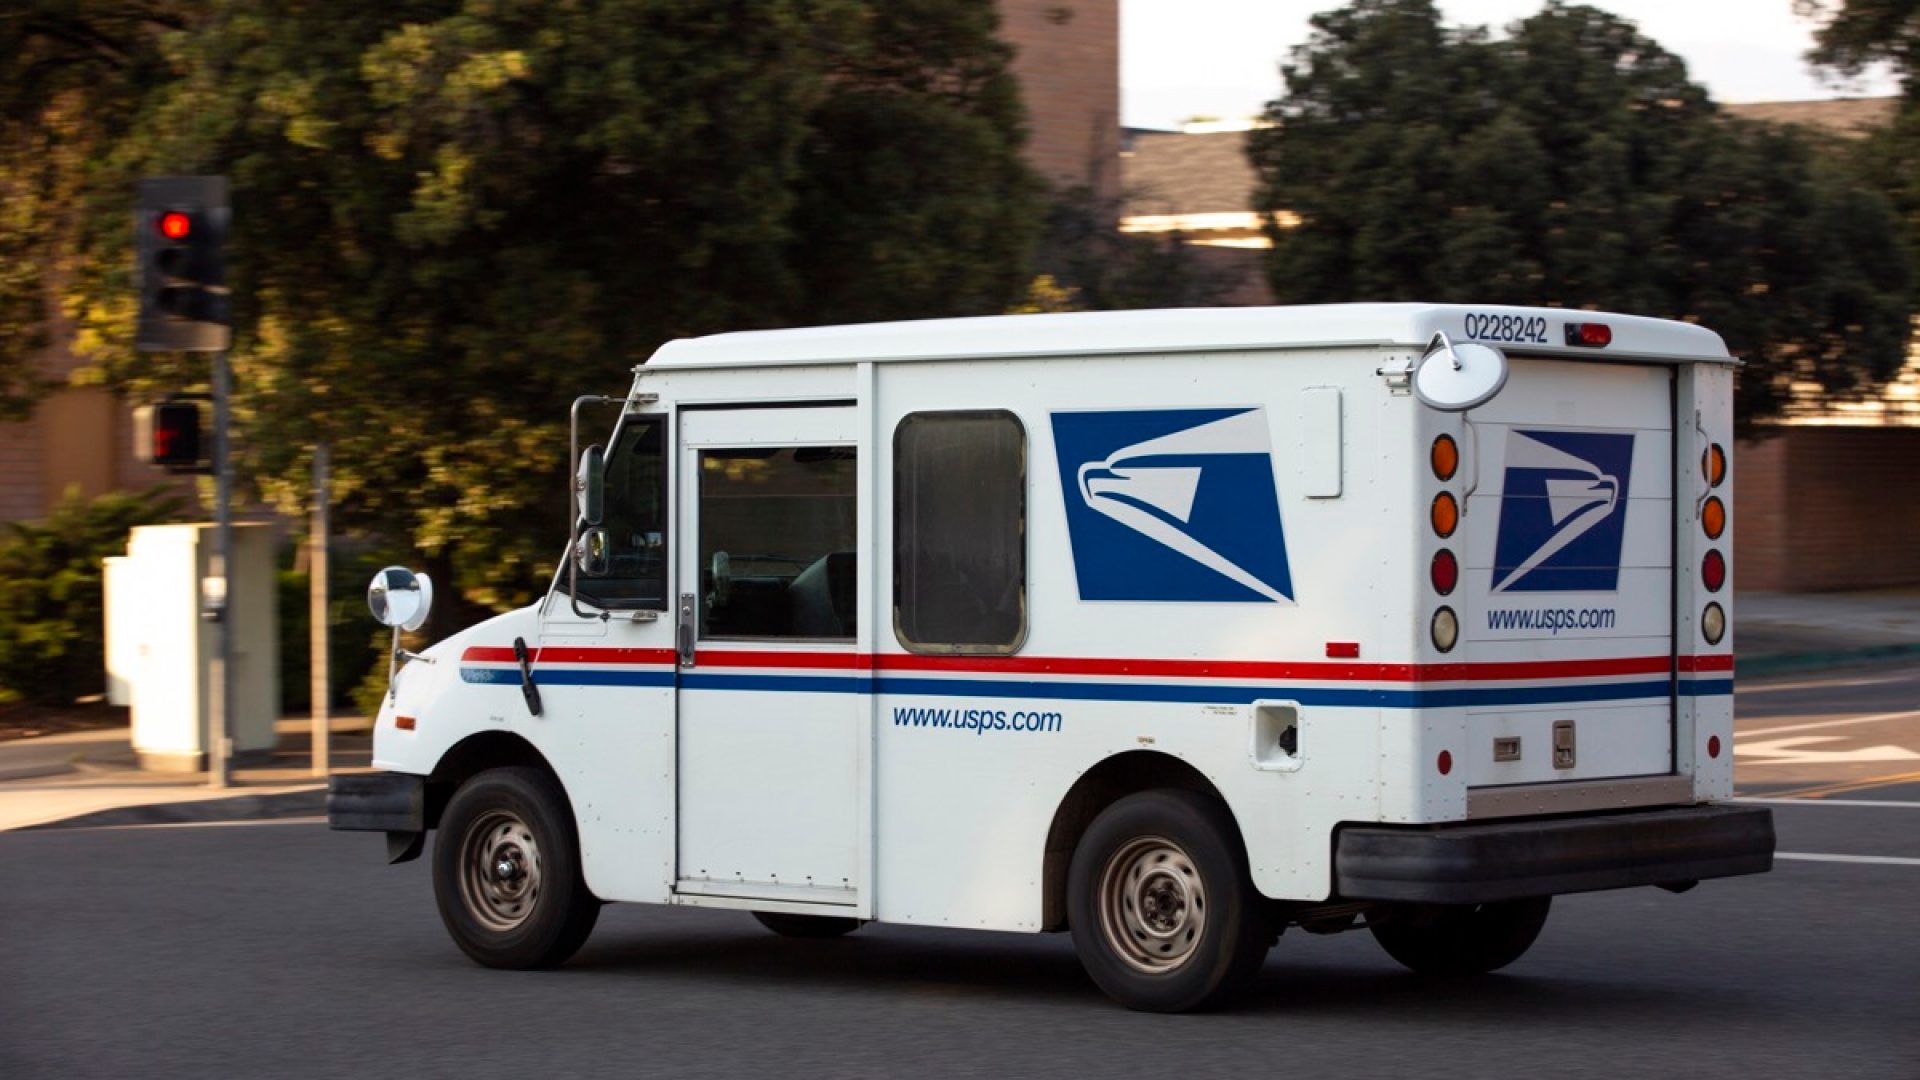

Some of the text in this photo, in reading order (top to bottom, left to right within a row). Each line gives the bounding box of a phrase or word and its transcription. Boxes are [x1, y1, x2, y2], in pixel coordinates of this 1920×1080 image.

[1465, 313, 1548, 343] 0228242
[1487, 608, 1616, 636] www.usps.com
[893, 706, 1063, 736] www.usps.com
